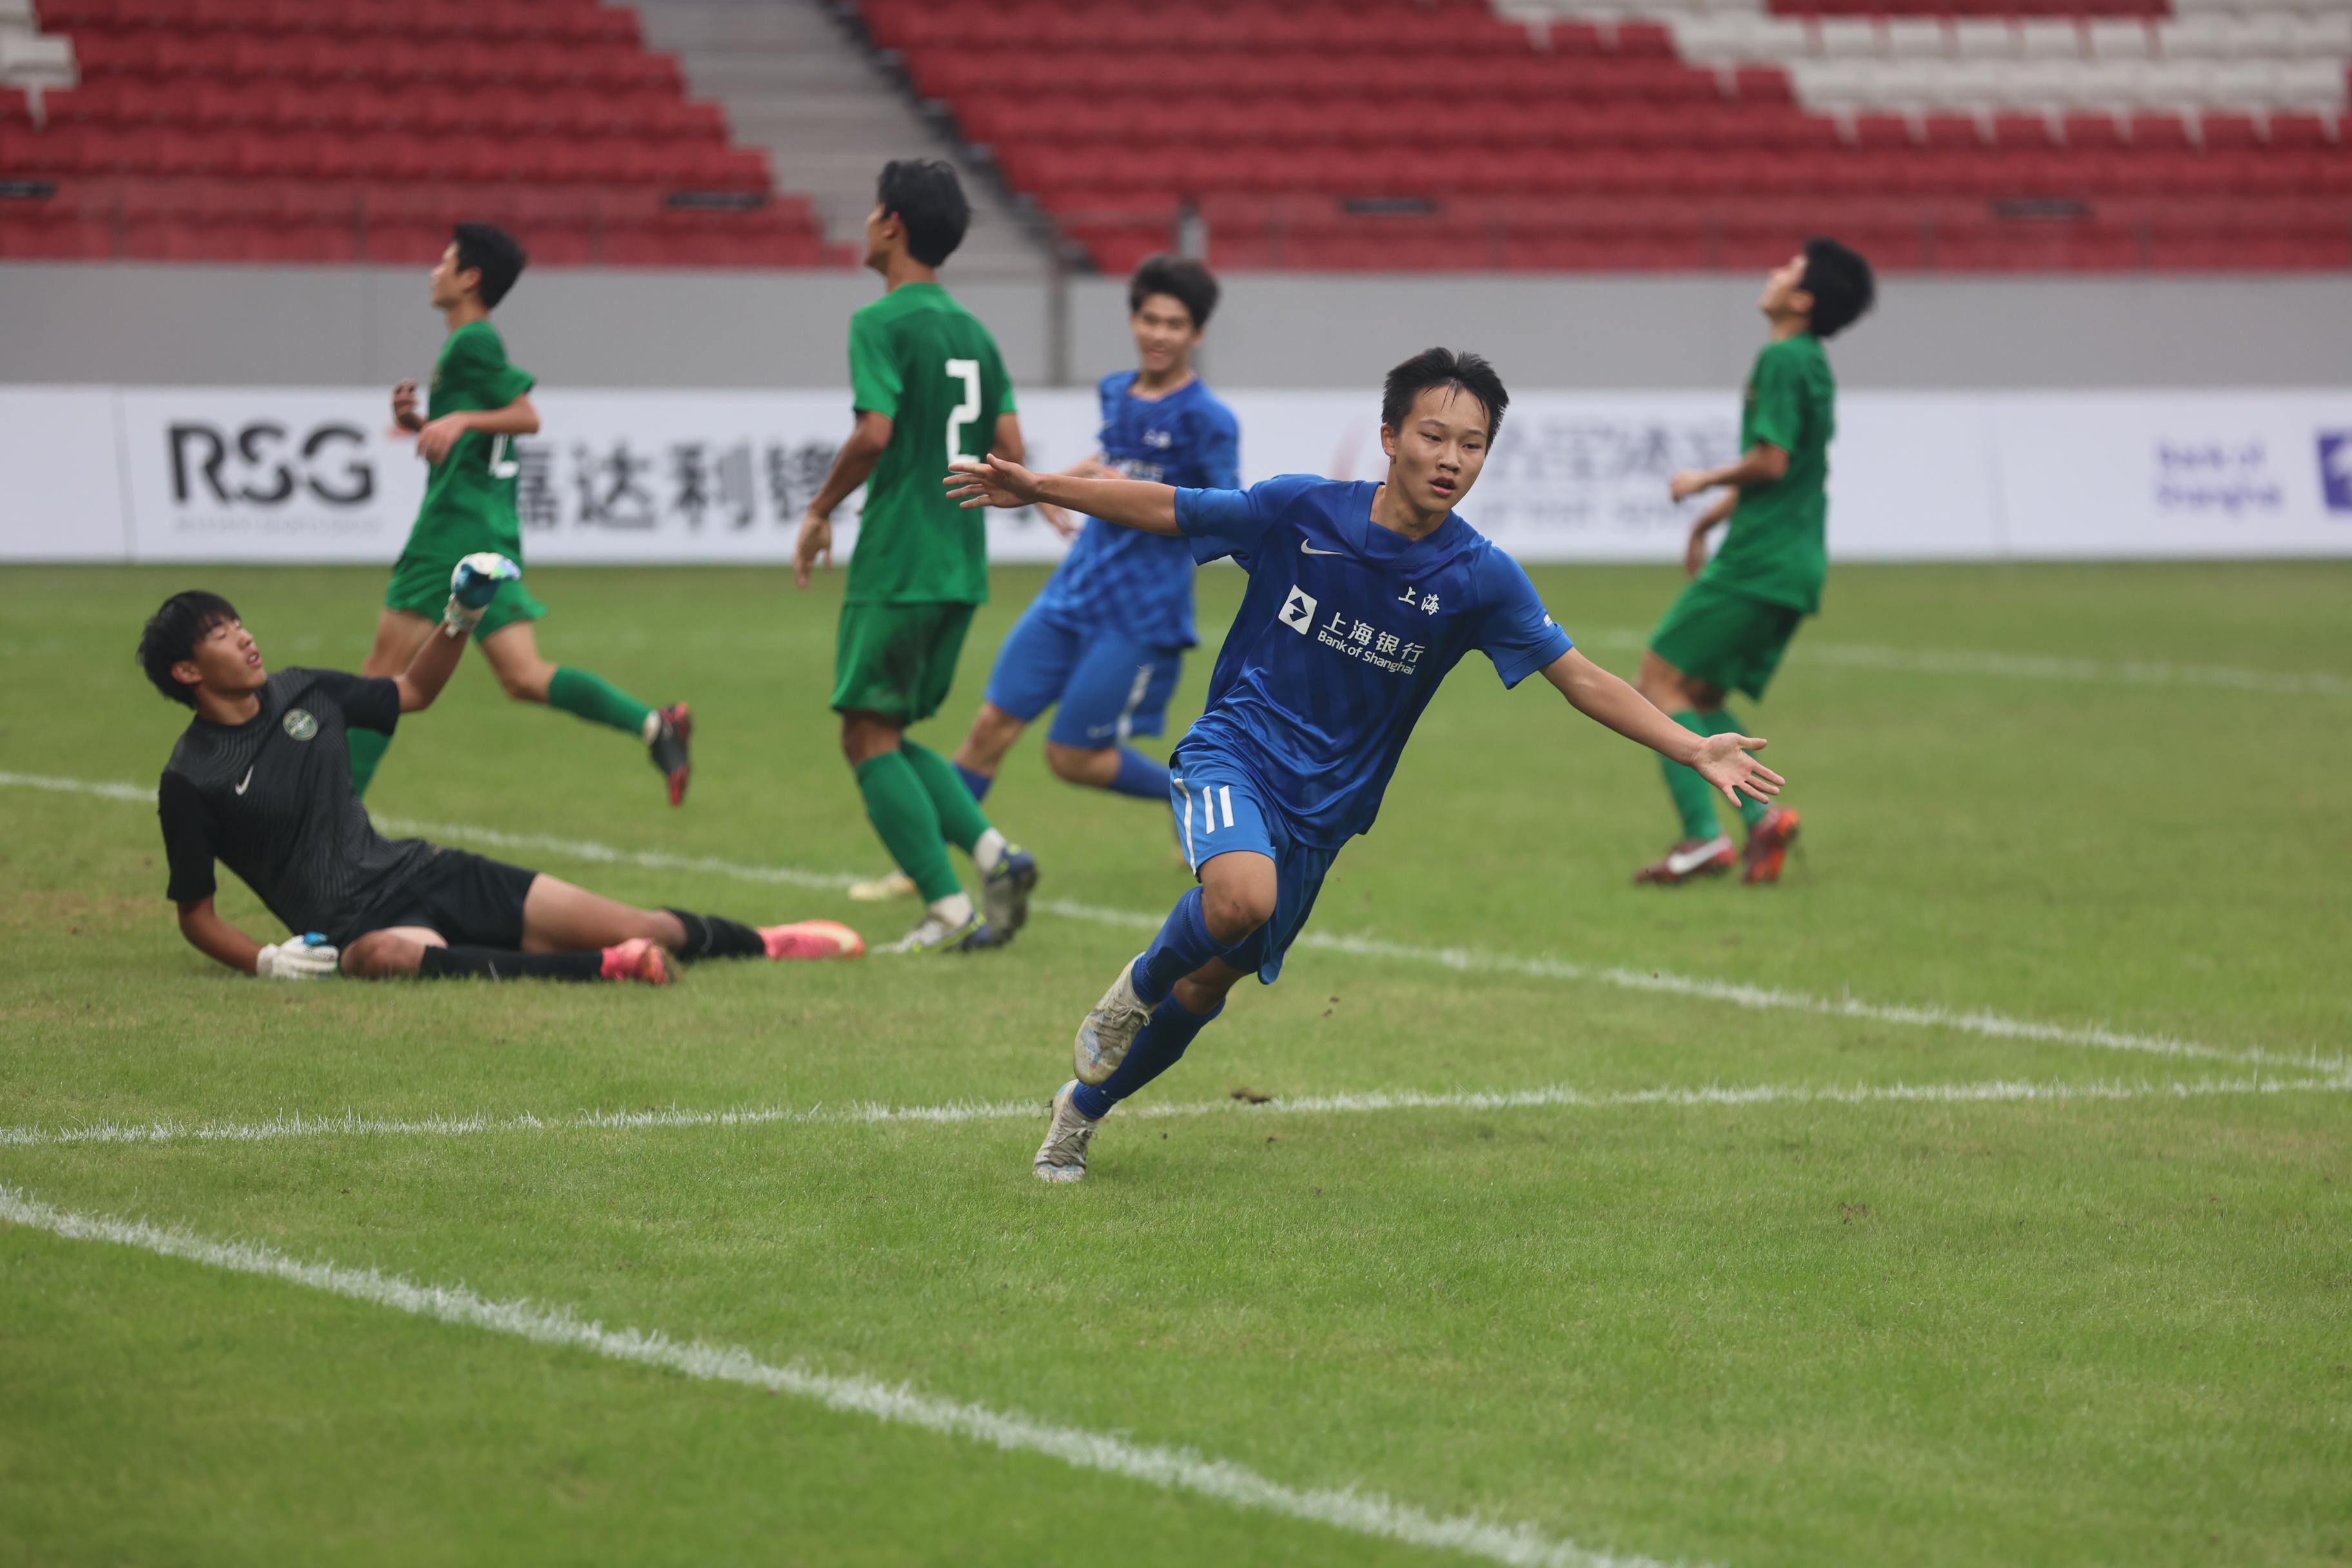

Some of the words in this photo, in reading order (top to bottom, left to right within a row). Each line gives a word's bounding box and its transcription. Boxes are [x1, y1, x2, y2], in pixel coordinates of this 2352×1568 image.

[945, 358, 981, 473] 2
[169, 420, 375, 507] RSG
[1398, 586, 1440, 616] 上海
[1317, 630, 1348, 653] Bank
[1347, 645, 1364, 658] of
[1362, 651, 1416, 676] Shanghai
[1322, 611, 1426, 663] 上海银行
[1202, 785, 1235, 835] 11
